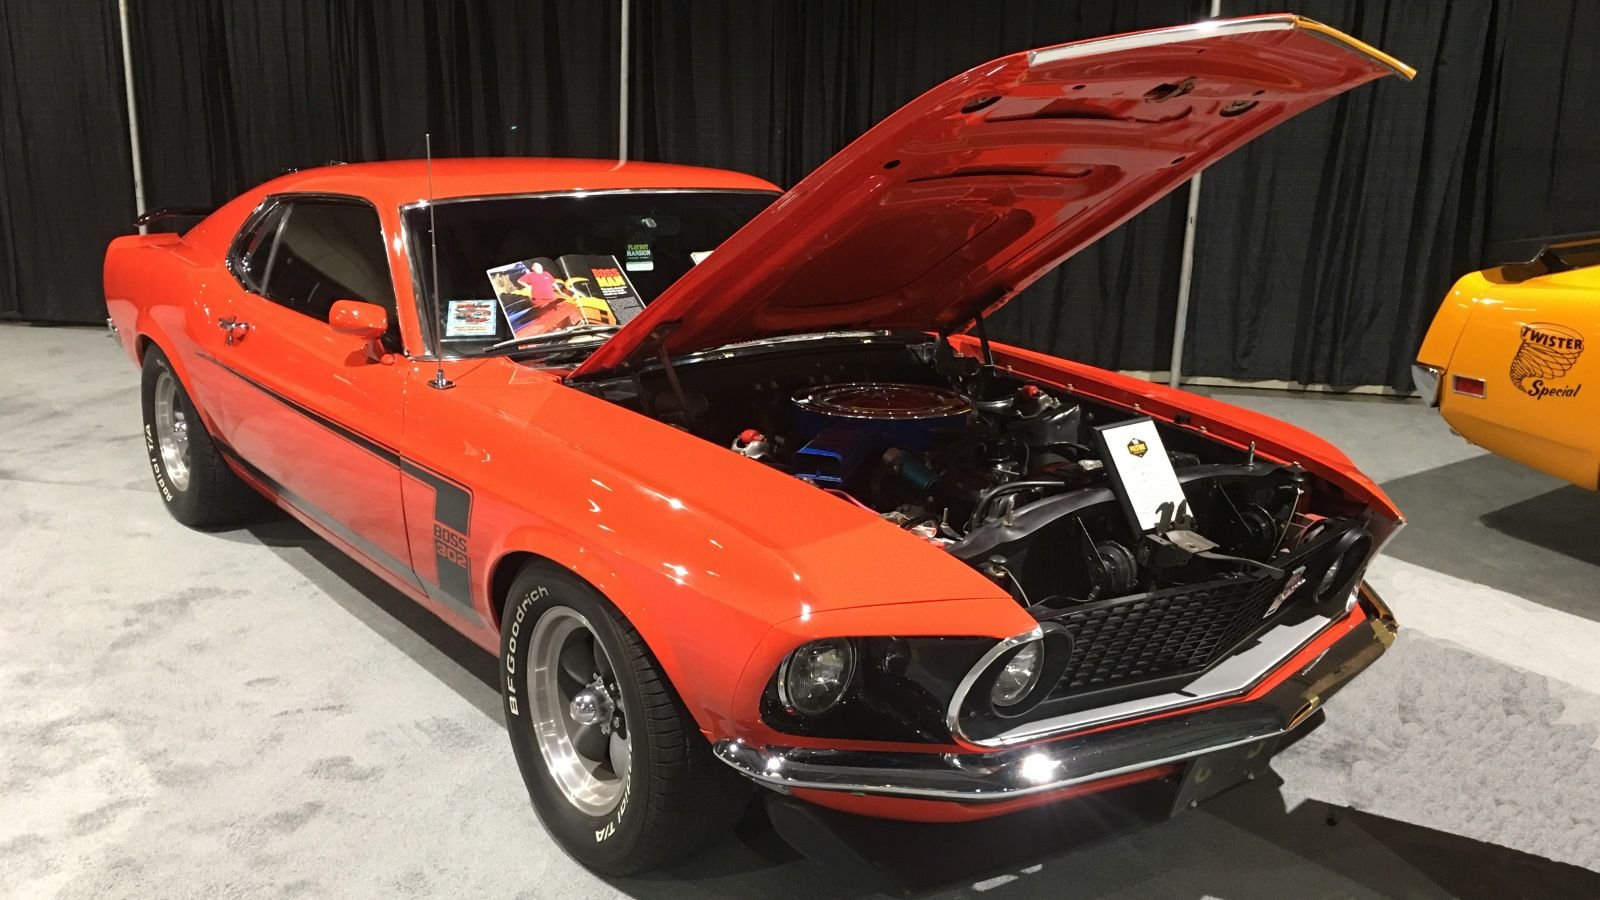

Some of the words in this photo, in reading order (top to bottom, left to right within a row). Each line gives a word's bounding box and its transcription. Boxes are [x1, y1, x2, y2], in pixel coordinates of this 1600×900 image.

[1522, 326, 1583, 350] TWISTER
[1528, 380, 1582, 400] Special
[434, 523, 467, 553] BOSS
[436, 542, 467, 569] 302
[595, 821, 616, 842] T/A
